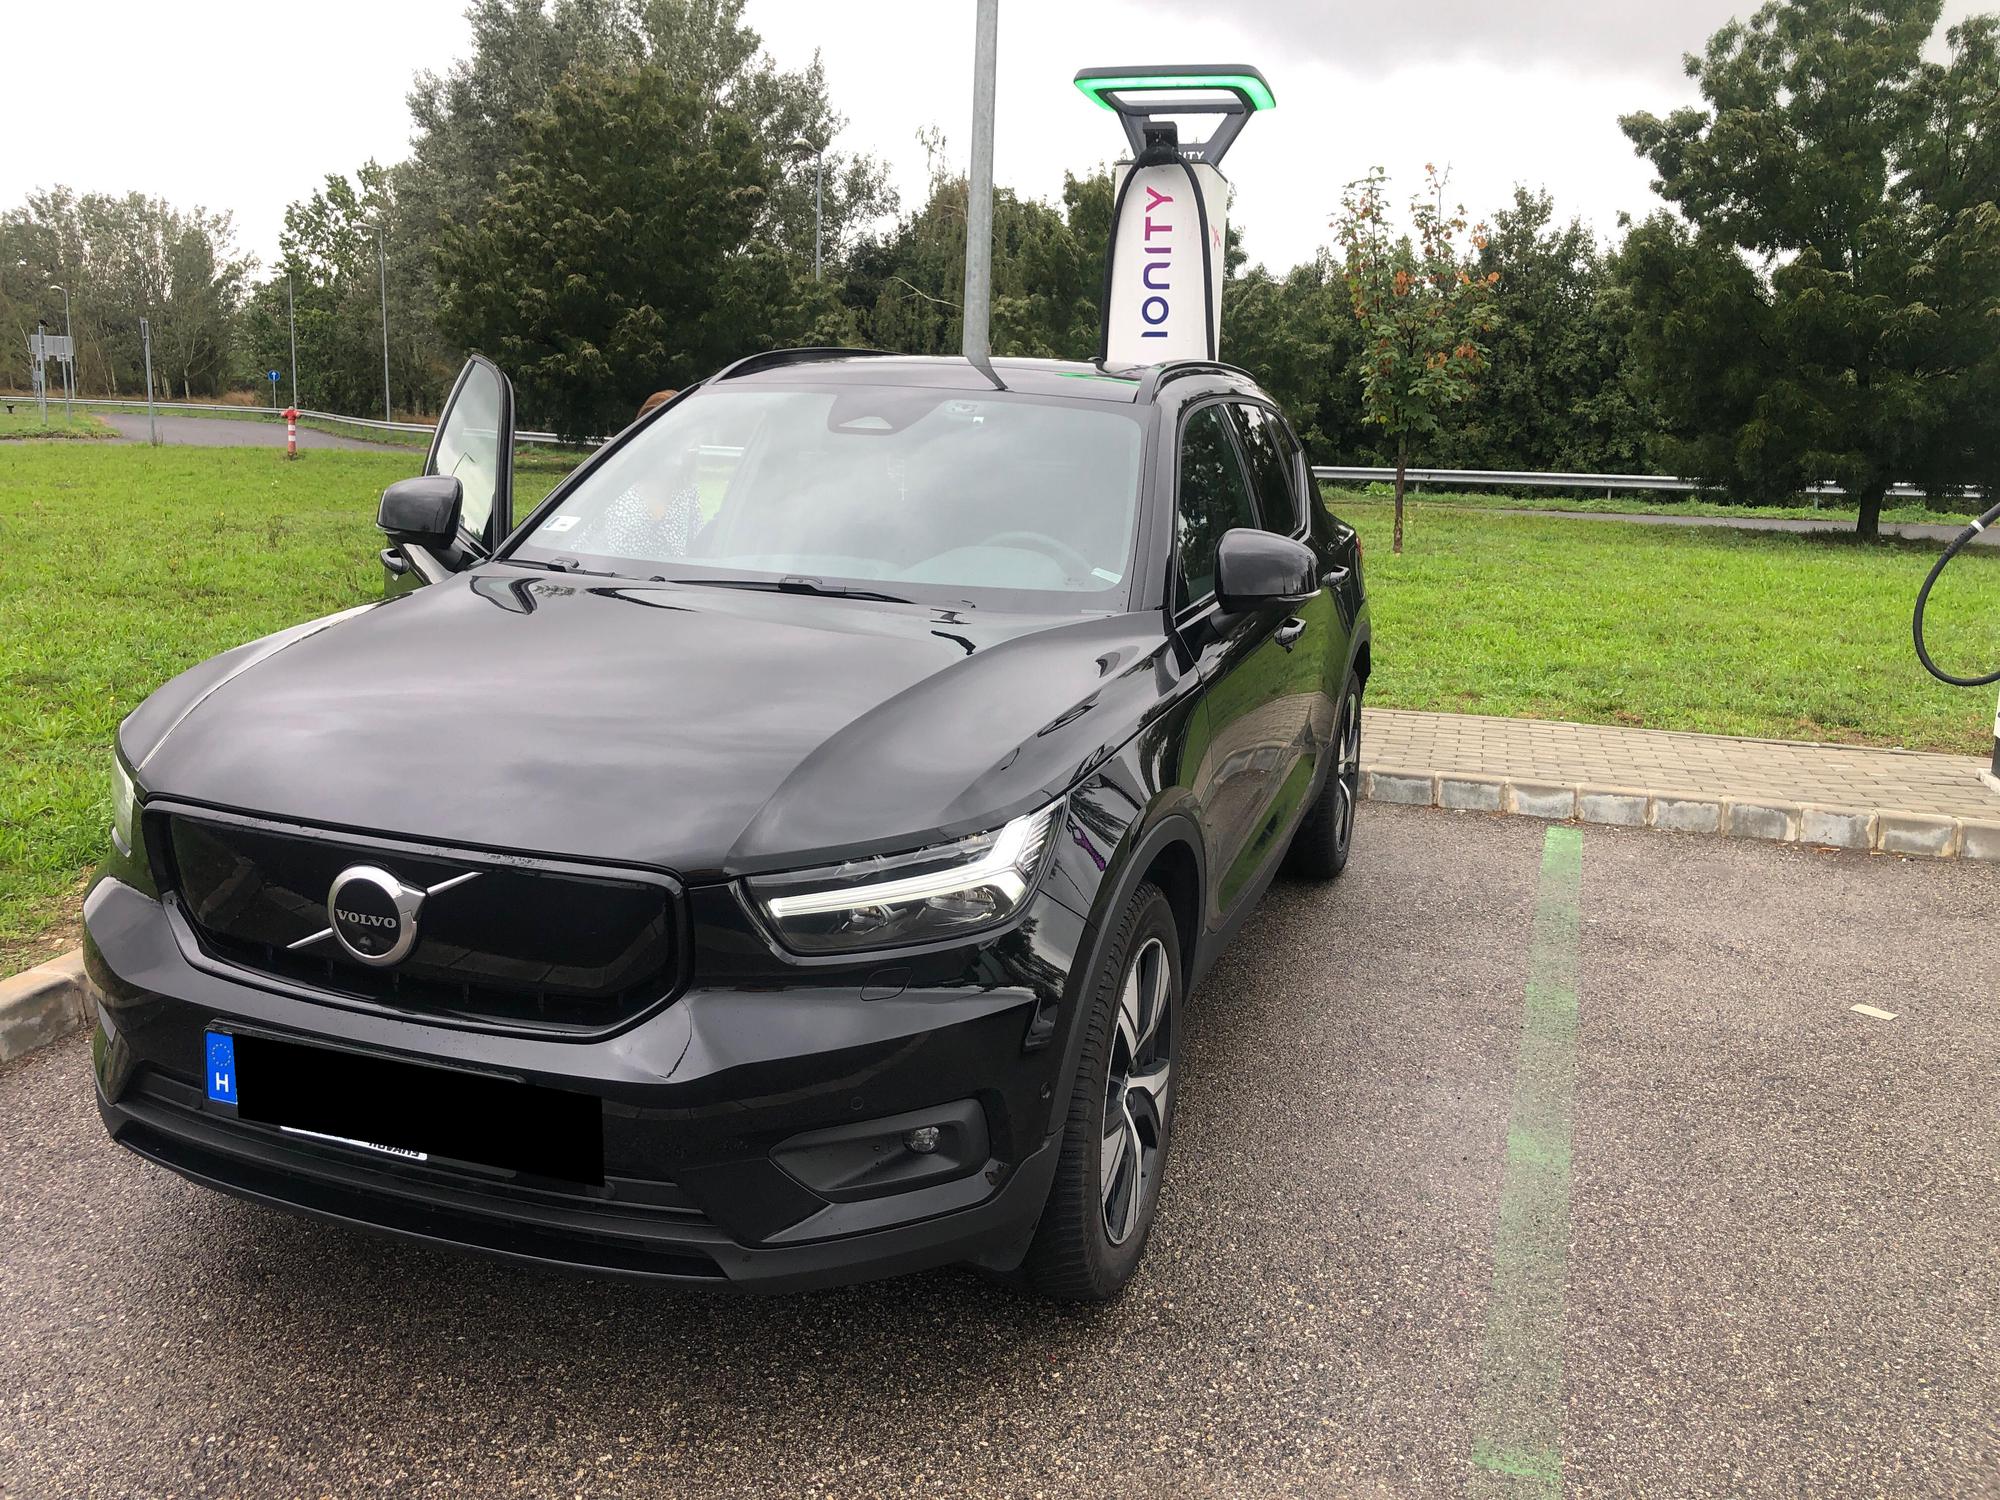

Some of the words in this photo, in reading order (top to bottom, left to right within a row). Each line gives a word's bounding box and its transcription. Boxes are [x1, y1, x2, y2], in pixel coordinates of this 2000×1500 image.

[1178, 151, 1205, 160] ITY
[1141, 186, 1174, 338] IONITY
[336, 908, 397, 929] VOLVO
[215, 1071, 229, 1093] H
